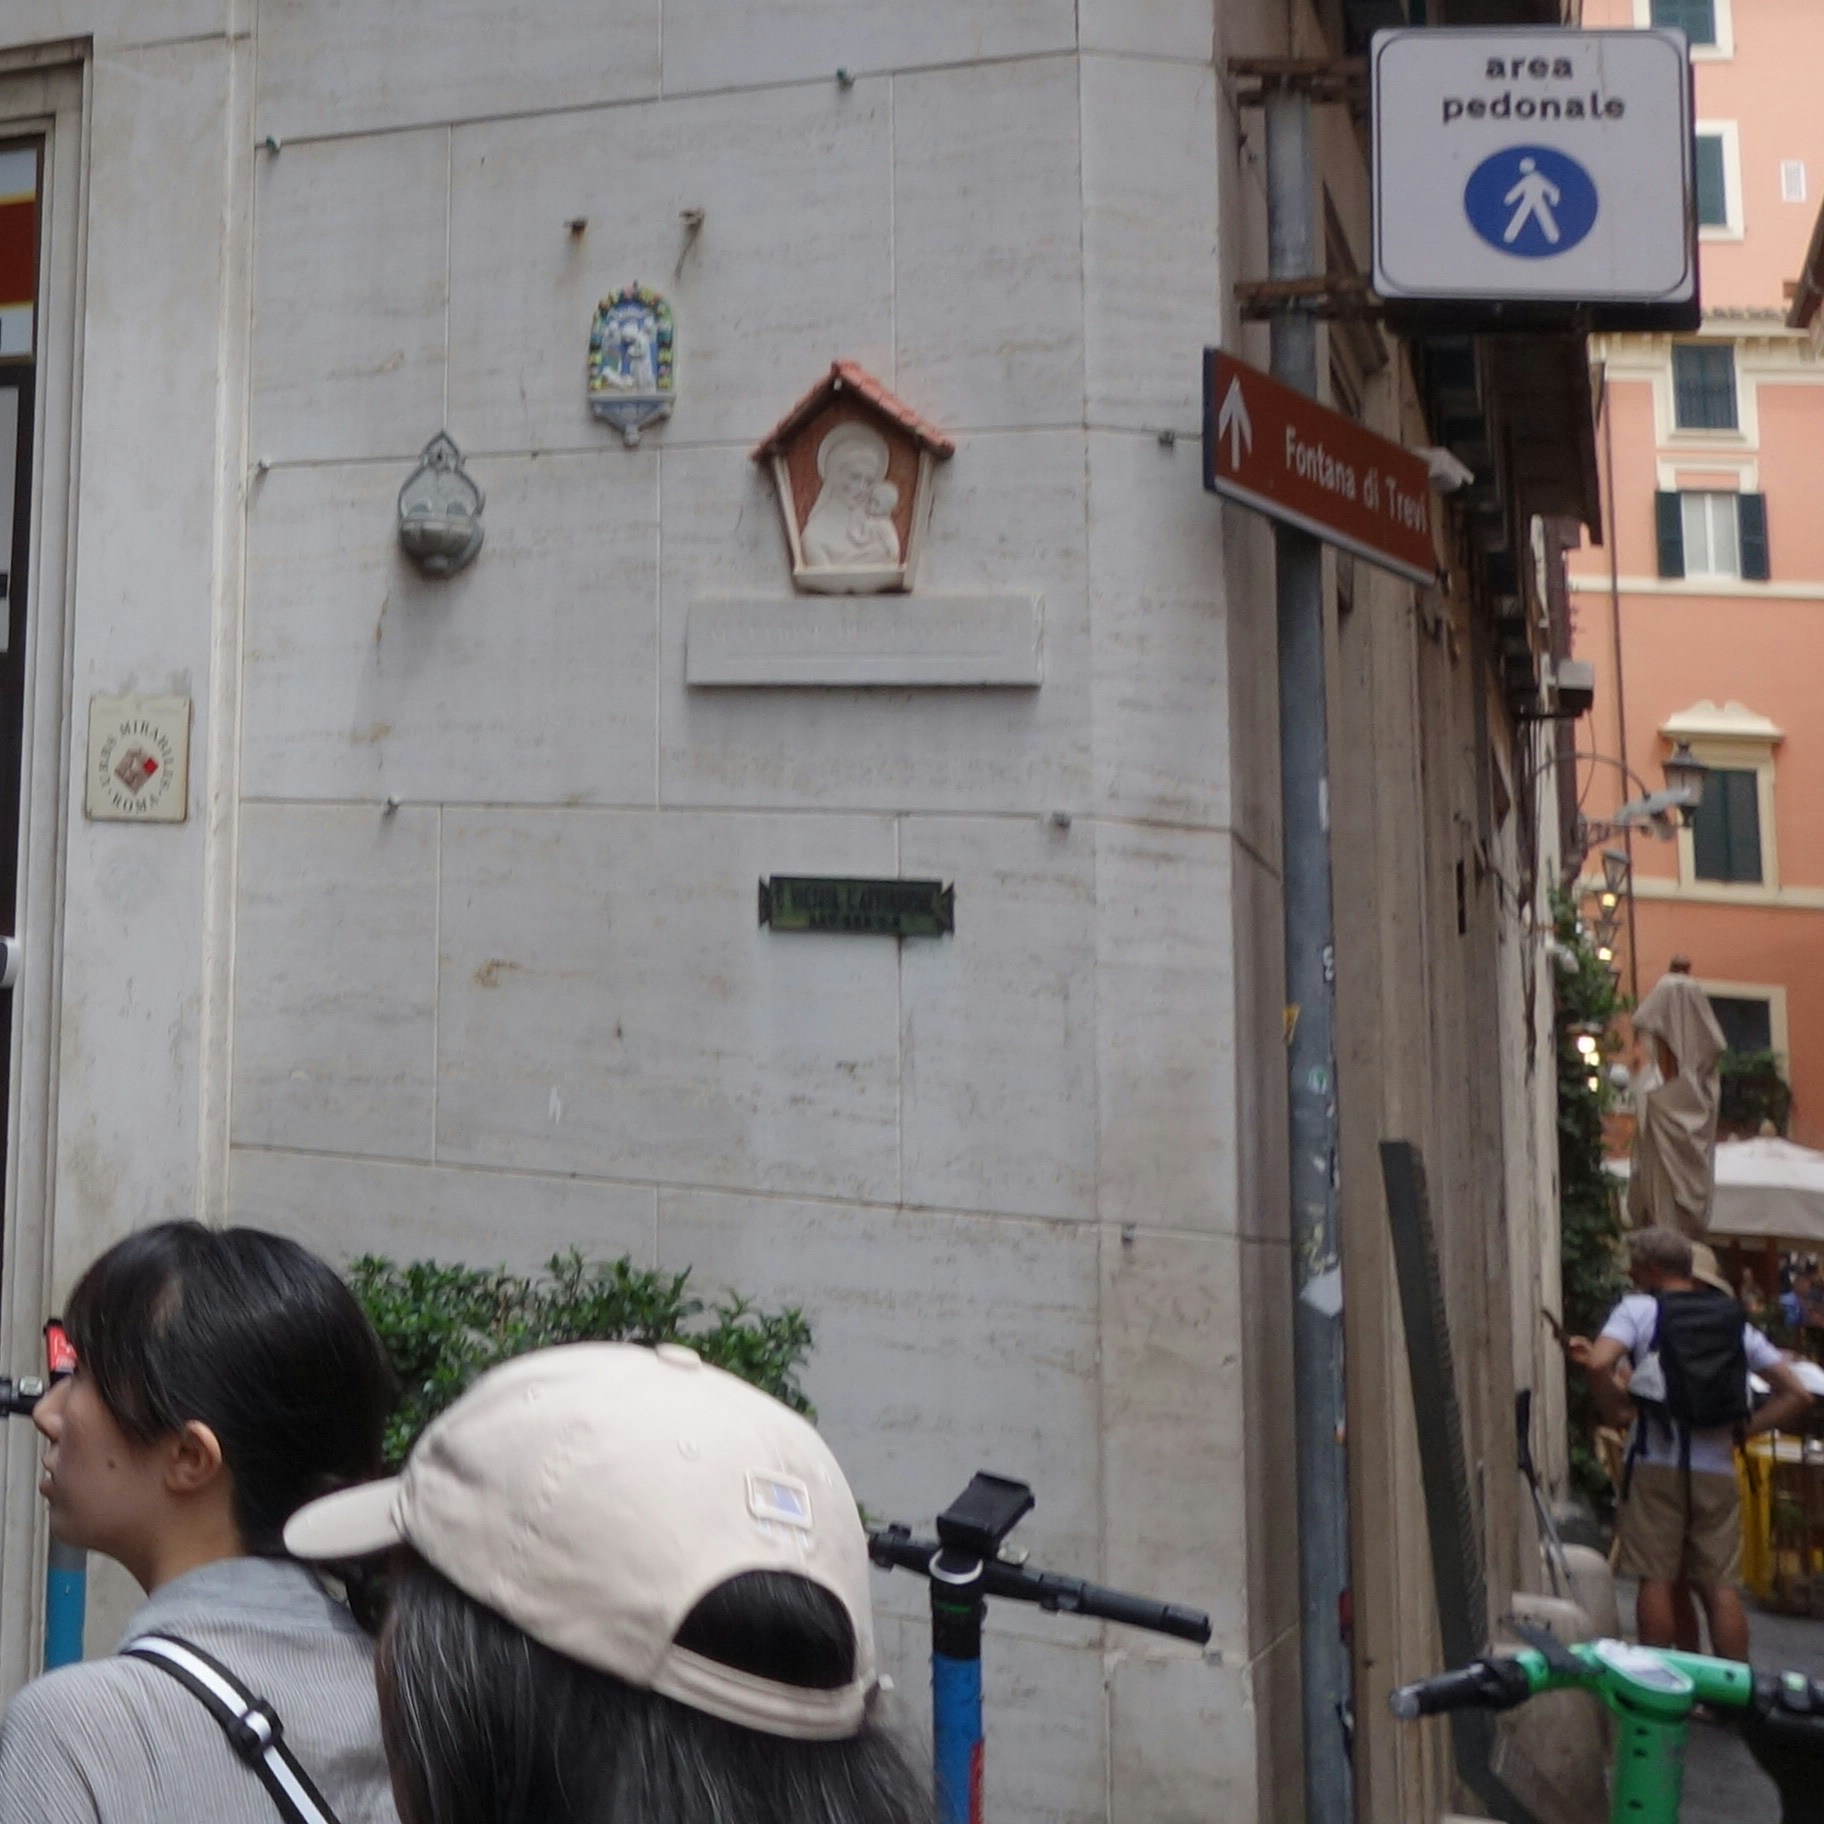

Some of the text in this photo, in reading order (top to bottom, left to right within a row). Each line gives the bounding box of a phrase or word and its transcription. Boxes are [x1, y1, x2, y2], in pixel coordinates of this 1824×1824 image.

[1485, 56, 1574, 80] area
[1442, 90, 1626, 126] pedonale
[1285, 423, 1427, 535] Fontana di Trevi
